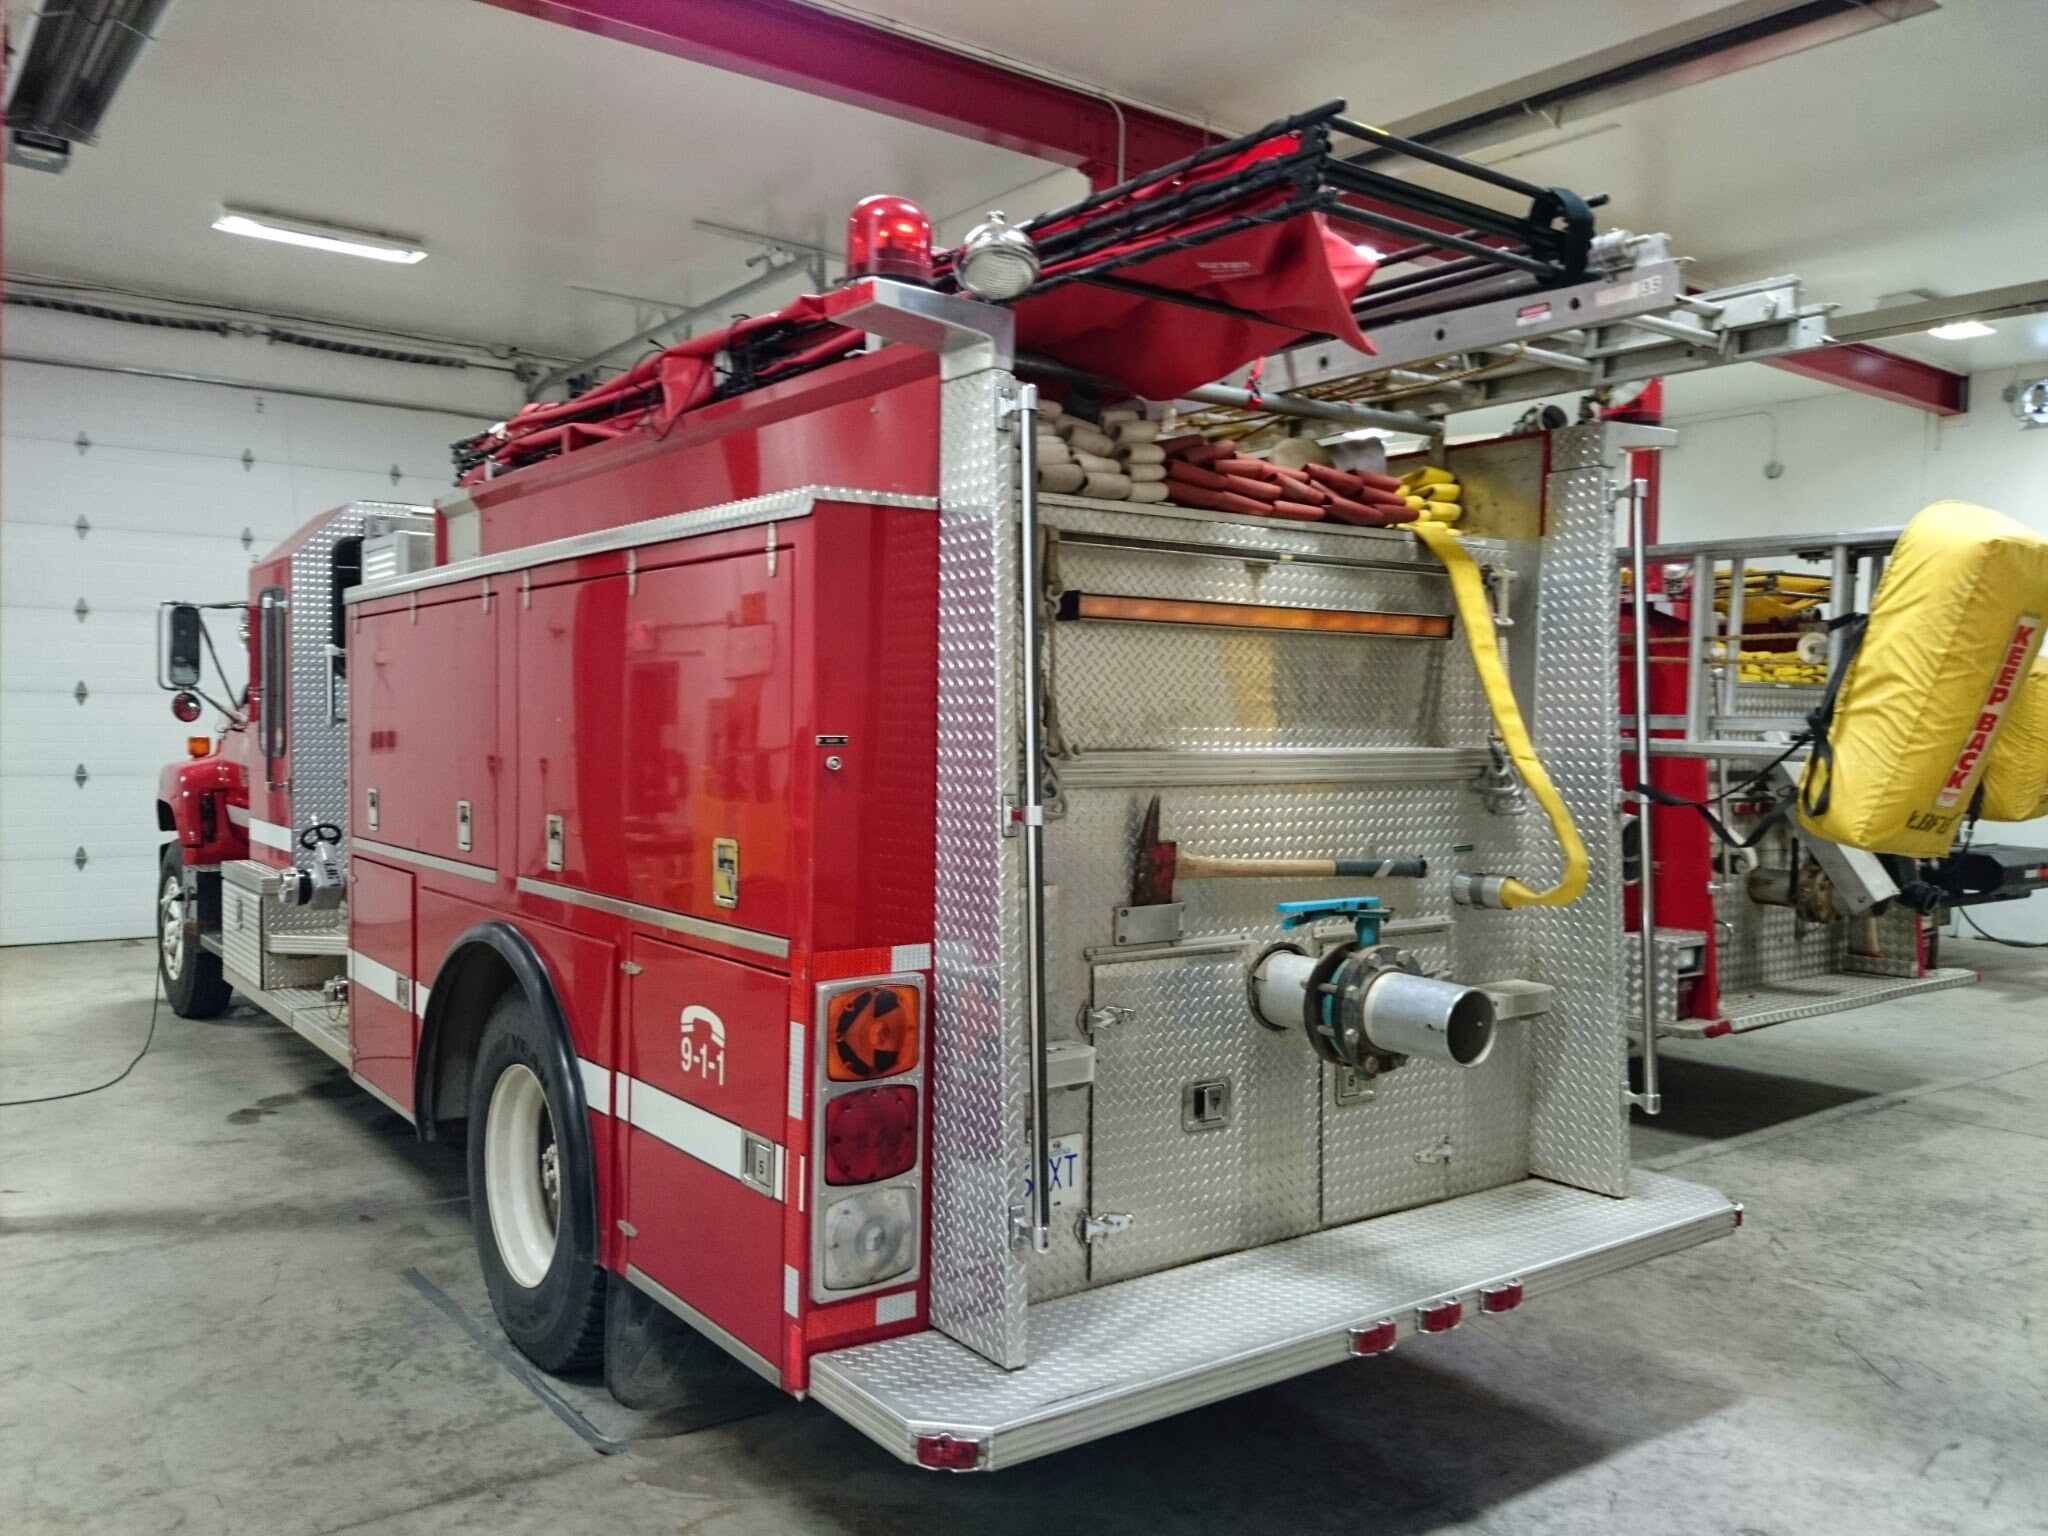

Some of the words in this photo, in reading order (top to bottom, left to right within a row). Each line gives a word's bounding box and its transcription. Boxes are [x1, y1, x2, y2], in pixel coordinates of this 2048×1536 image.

[1987, 624, 2035, 706] KEEP
[1946, 713, 1998, 789] BACK
[681, 1036, 725, 1086] 9-1-1
[758, 1160, 765, 1175] 5
